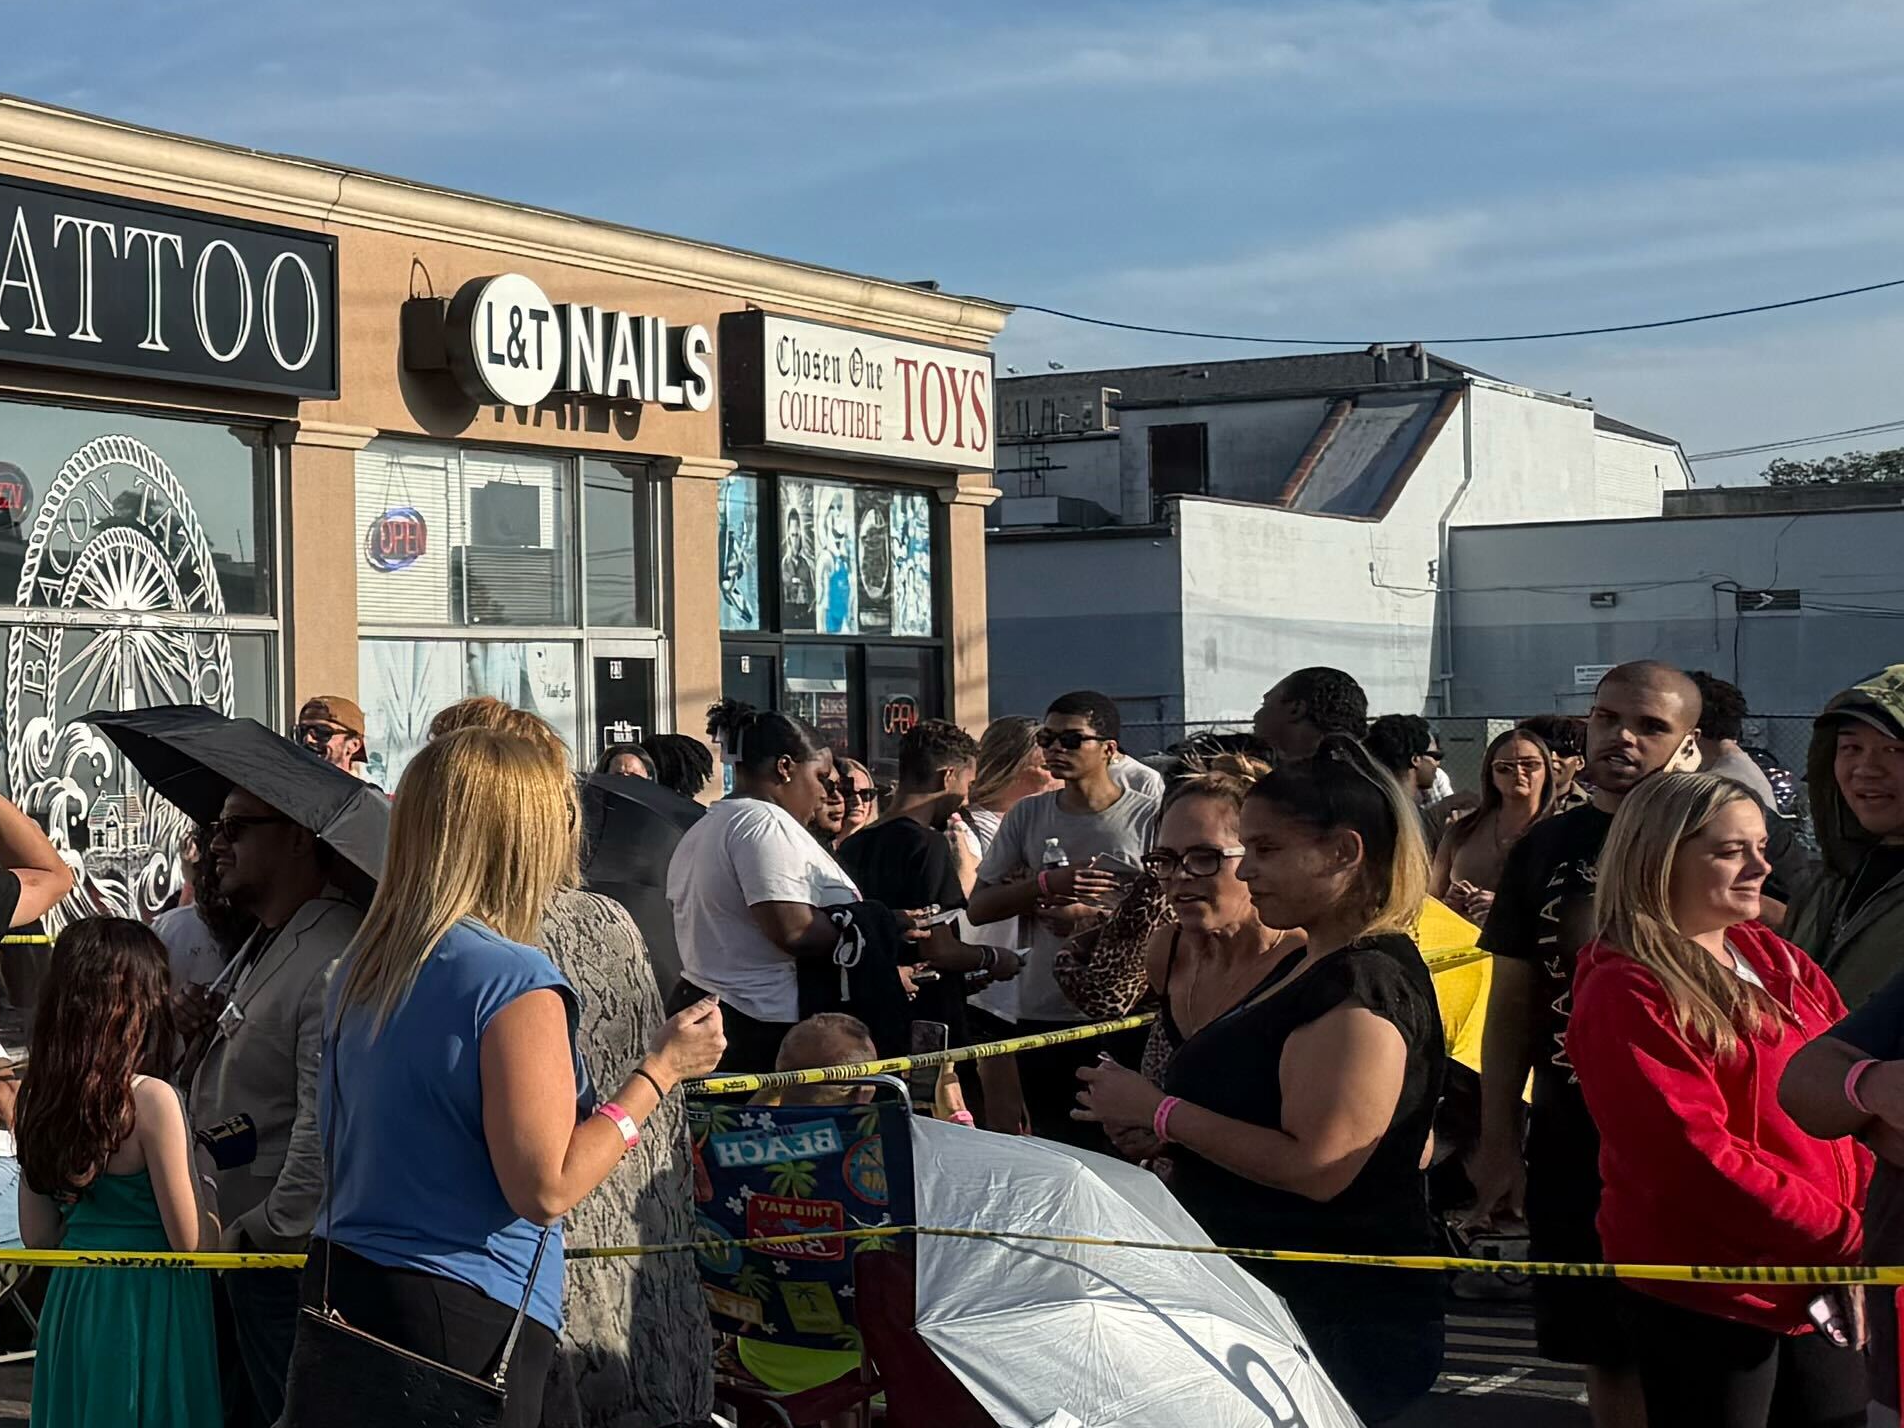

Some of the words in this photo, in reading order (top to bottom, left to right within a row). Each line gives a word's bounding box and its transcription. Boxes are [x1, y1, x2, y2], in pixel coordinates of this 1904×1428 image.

[486, 300, 550, 373] L&T
[570, 303, 714, 413] NAILS
[776, 334, 842, 385] Chosen
[848, 346, 884, 393] One
[778, 389, 883, 442] COLLECTIBLE
[894, 355, 987, 453] TOYS
[379, 520, 427, 556] OPEN
